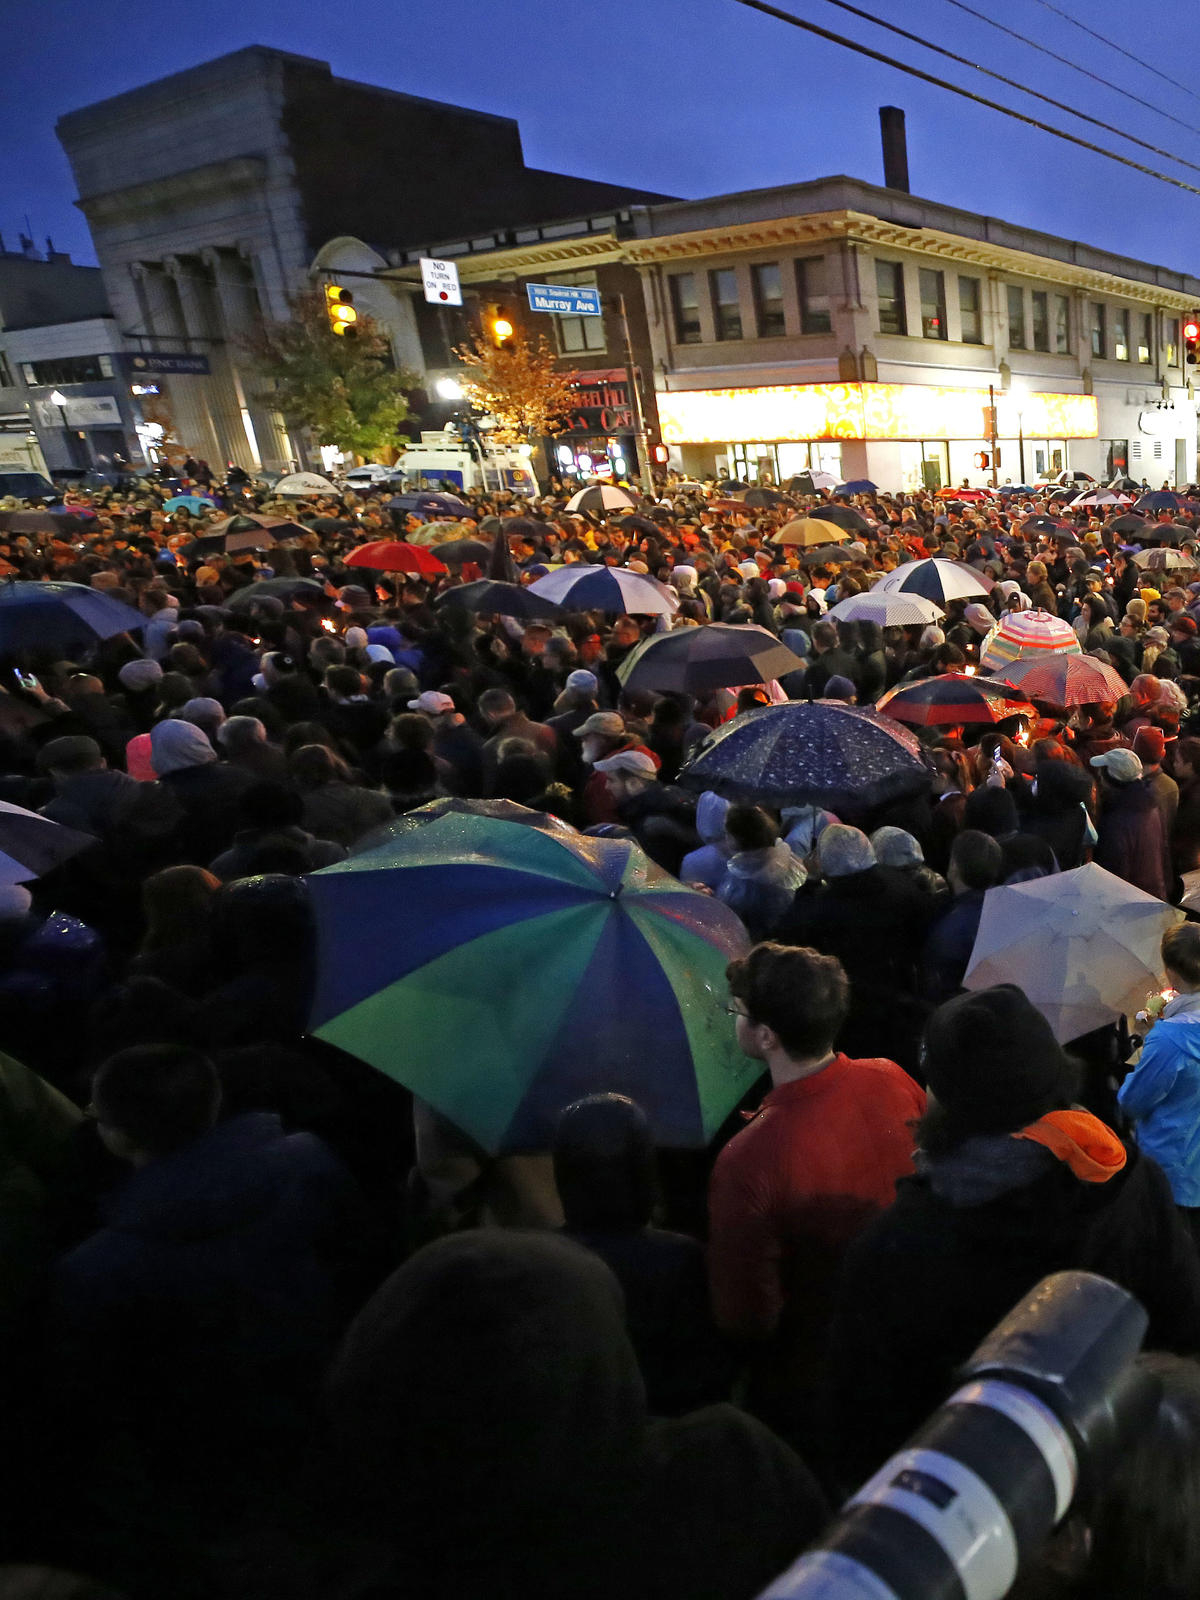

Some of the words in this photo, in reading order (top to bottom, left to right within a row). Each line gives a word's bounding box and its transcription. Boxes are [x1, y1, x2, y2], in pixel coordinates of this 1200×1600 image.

[433, 262, 445, 272] NO
[431, 271, 450, 281] TURN
[426, 281, 437, 290] ON
[442, 283, 457, 292] RED
[534, 296, 572, 311] Murray
[576, 300, 595, 311] Ave
[603, 385, 629, 407] HILL
[601, 408, 633, 431] CAF
